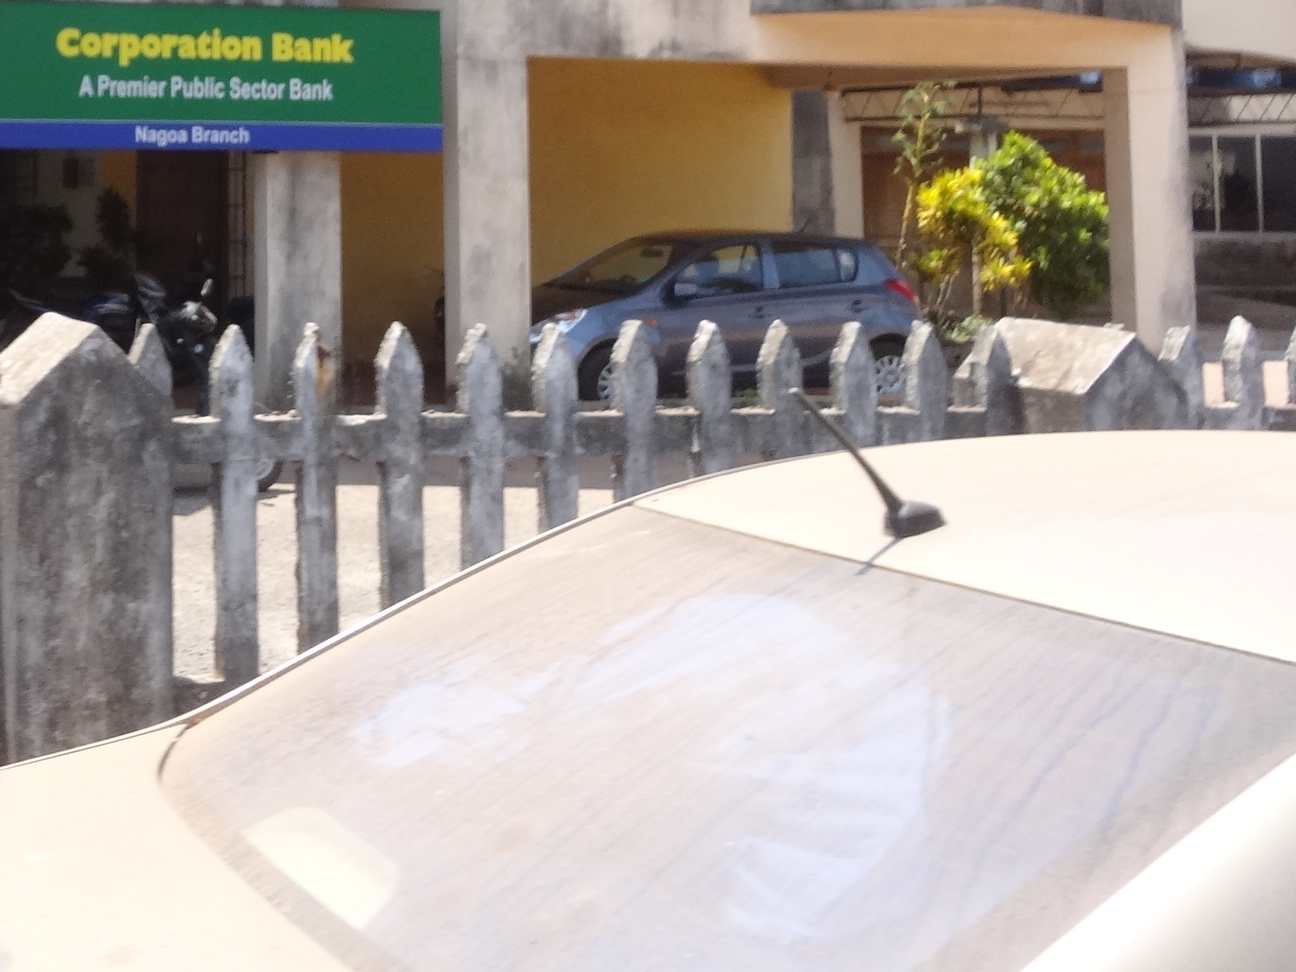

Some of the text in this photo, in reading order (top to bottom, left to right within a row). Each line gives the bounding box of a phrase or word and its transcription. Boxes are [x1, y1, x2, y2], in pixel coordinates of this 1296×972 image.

[56, 27, 354, 67] Corporation Bank
[79, 74, 333, 100] A Premier Public Sector Bank
[134, 125, 250, 147] Nagoa Branch
